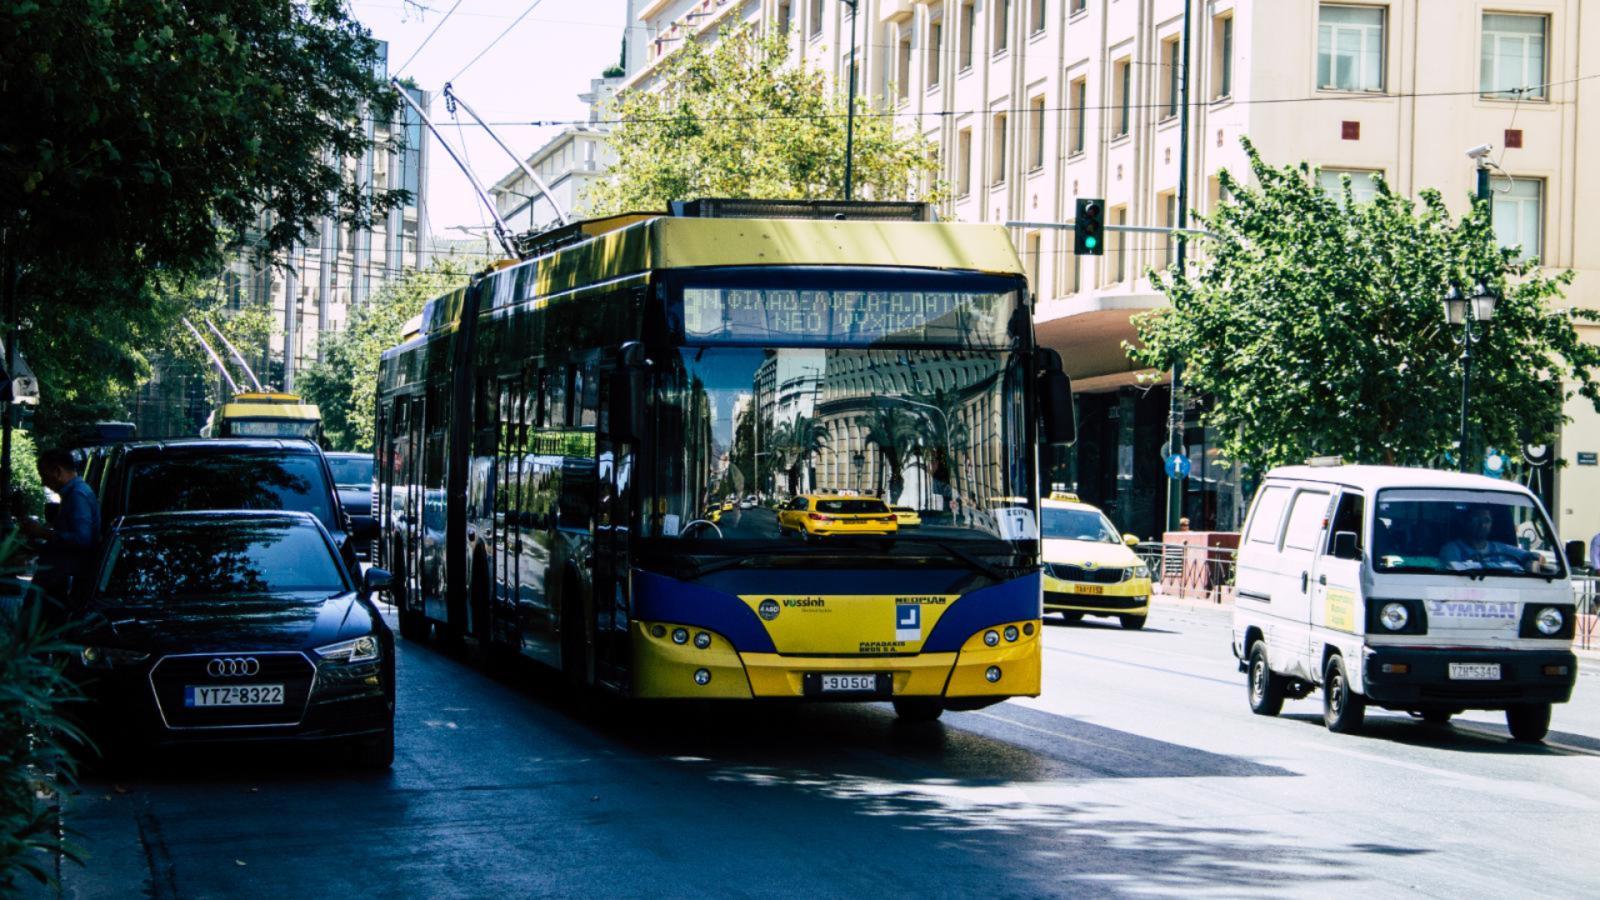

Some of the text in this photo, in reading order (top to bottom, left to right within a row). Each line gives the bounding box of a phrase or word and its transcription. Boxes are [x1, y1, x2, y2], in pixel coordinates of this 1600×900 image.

[775, 312, 821, 332] ΝΕΟ
[1016, 518, 1024, 532] 7
[200, 687, 282, 704] YTZ-8322
